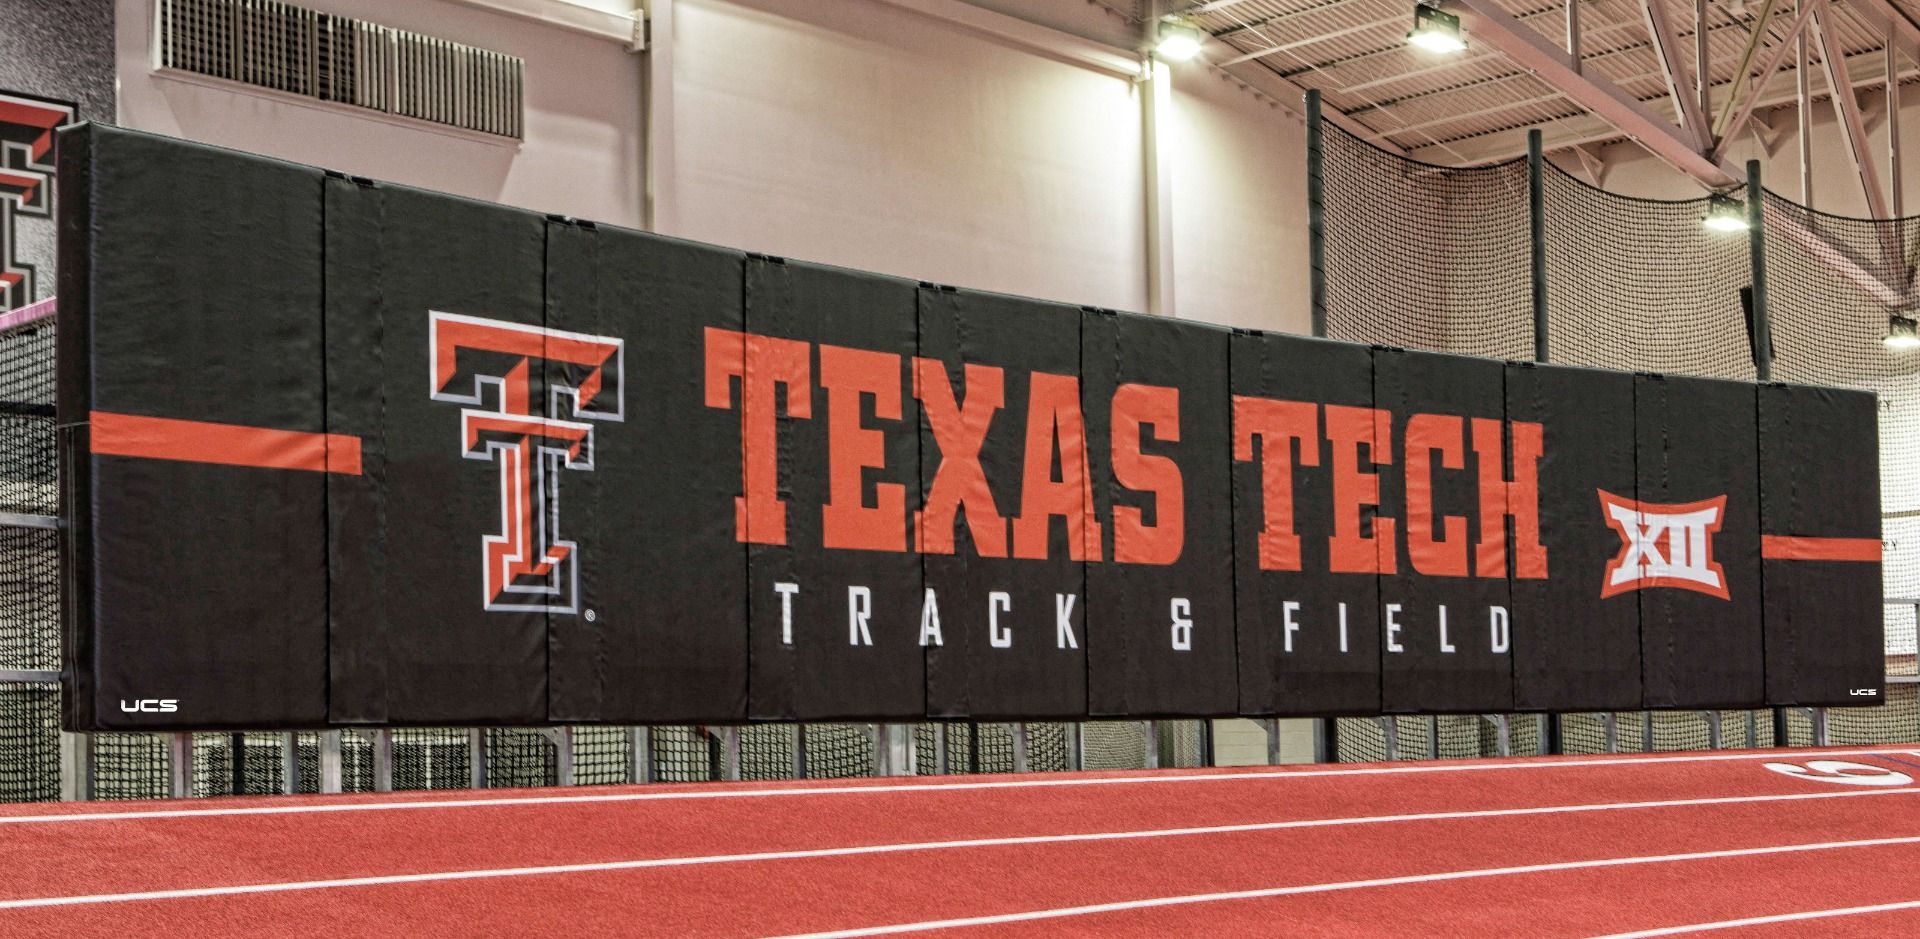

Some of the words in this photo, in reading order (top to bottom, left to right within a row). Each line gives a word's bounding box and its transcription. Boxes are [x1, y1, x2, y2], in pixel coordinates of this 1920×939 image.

[704, 327, 1184, 565] TEXAS
[1233, 395, 1549, 579] TECH
[775, 583, 1078, 649] TRACK
[1170, 597, 1193, 650] &
[1283, 601, 1510, 653] FIELD
[120, 699, 178, 712] UCS
